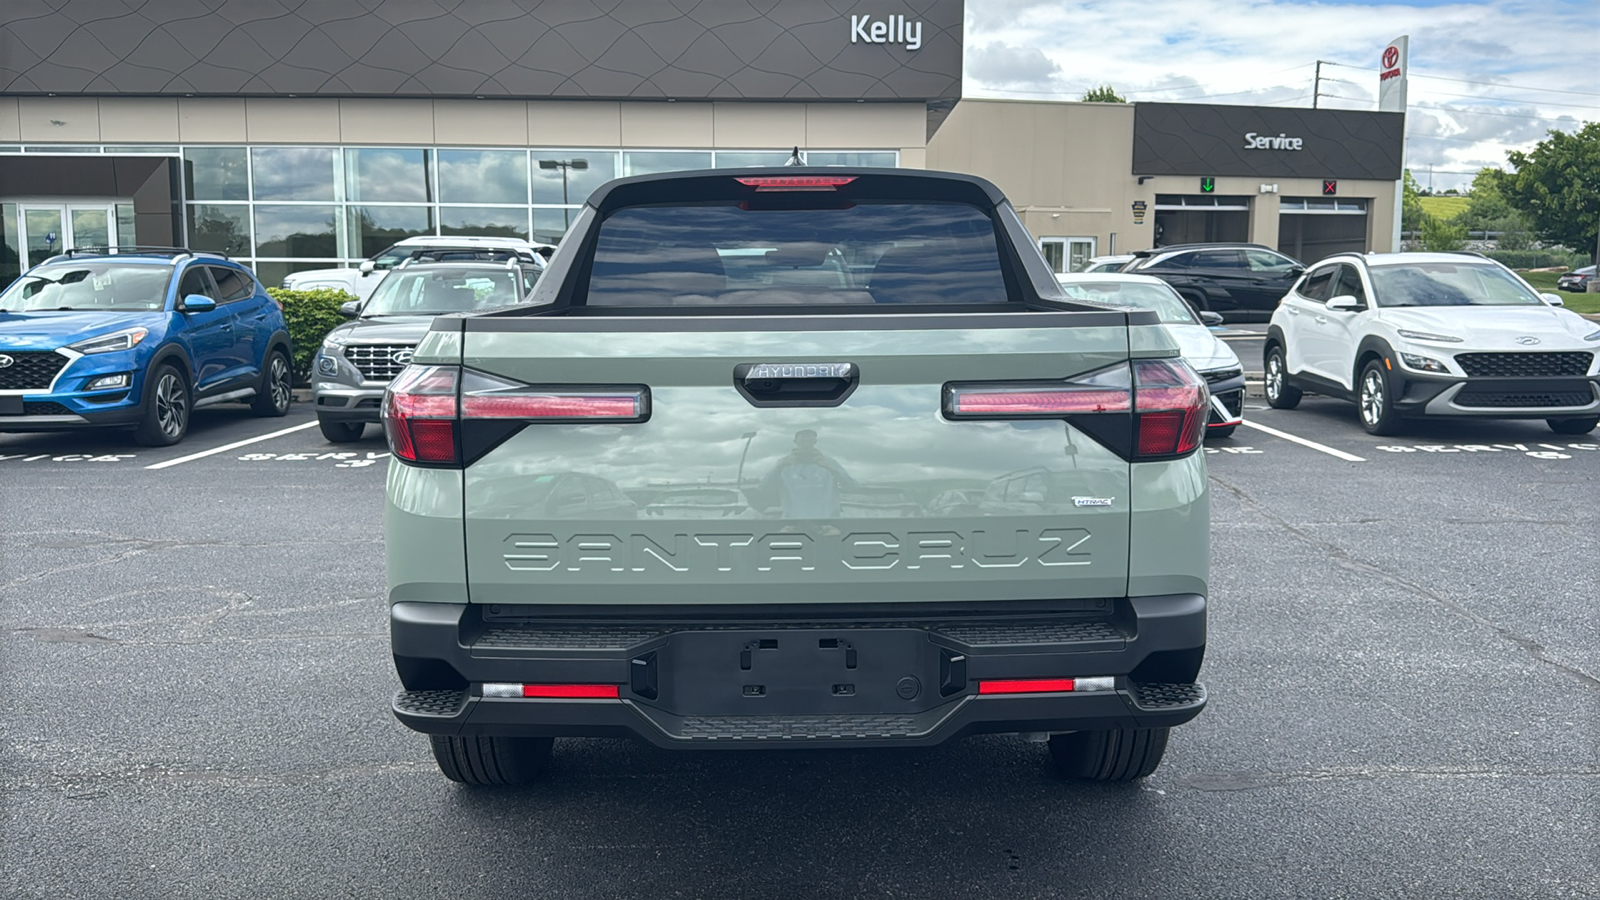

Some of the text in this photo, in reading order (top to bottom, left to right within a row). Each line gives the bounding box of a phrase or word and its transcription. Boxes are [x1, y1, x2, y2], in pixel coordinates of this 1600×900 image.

[851, 14, 922, 50] Kelly
[1244, 132, 1303, 151] Service
[759, 365, 836, 378] HYUNDAI
[1376, 443, 1600, 453] SERVIC
[238, 452, 392, 461] SERV
[503, 527, 1092, 572] SANTA CRUZ
